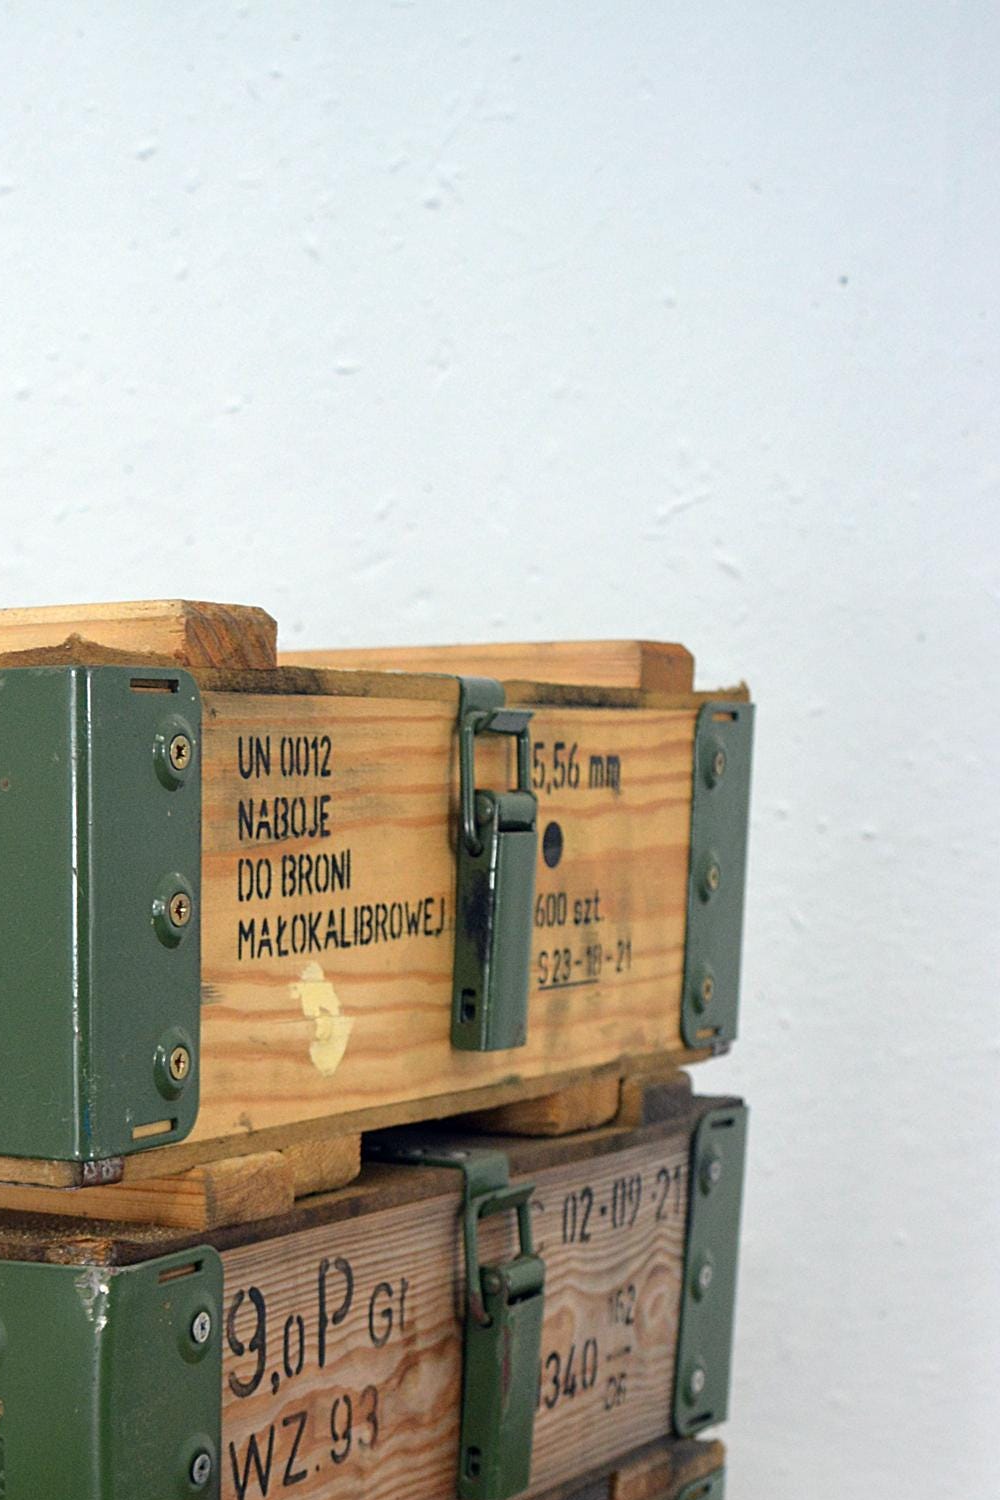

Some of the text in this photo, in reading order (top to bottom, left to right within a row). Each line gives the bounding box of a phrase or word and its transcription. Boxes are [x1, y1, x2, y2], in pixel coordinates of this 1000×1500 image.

[238, 735, 332, 779] UN 0012
[532, 742, 622, 794] 5,56 mm
[238, 795, 332, 841] NABOJE
[238, 849, 351, 902] DO BRONI
[238, 897, 445, 961] MAŁOKALIBROWEJ
[535, 892, 567, 928] 600
